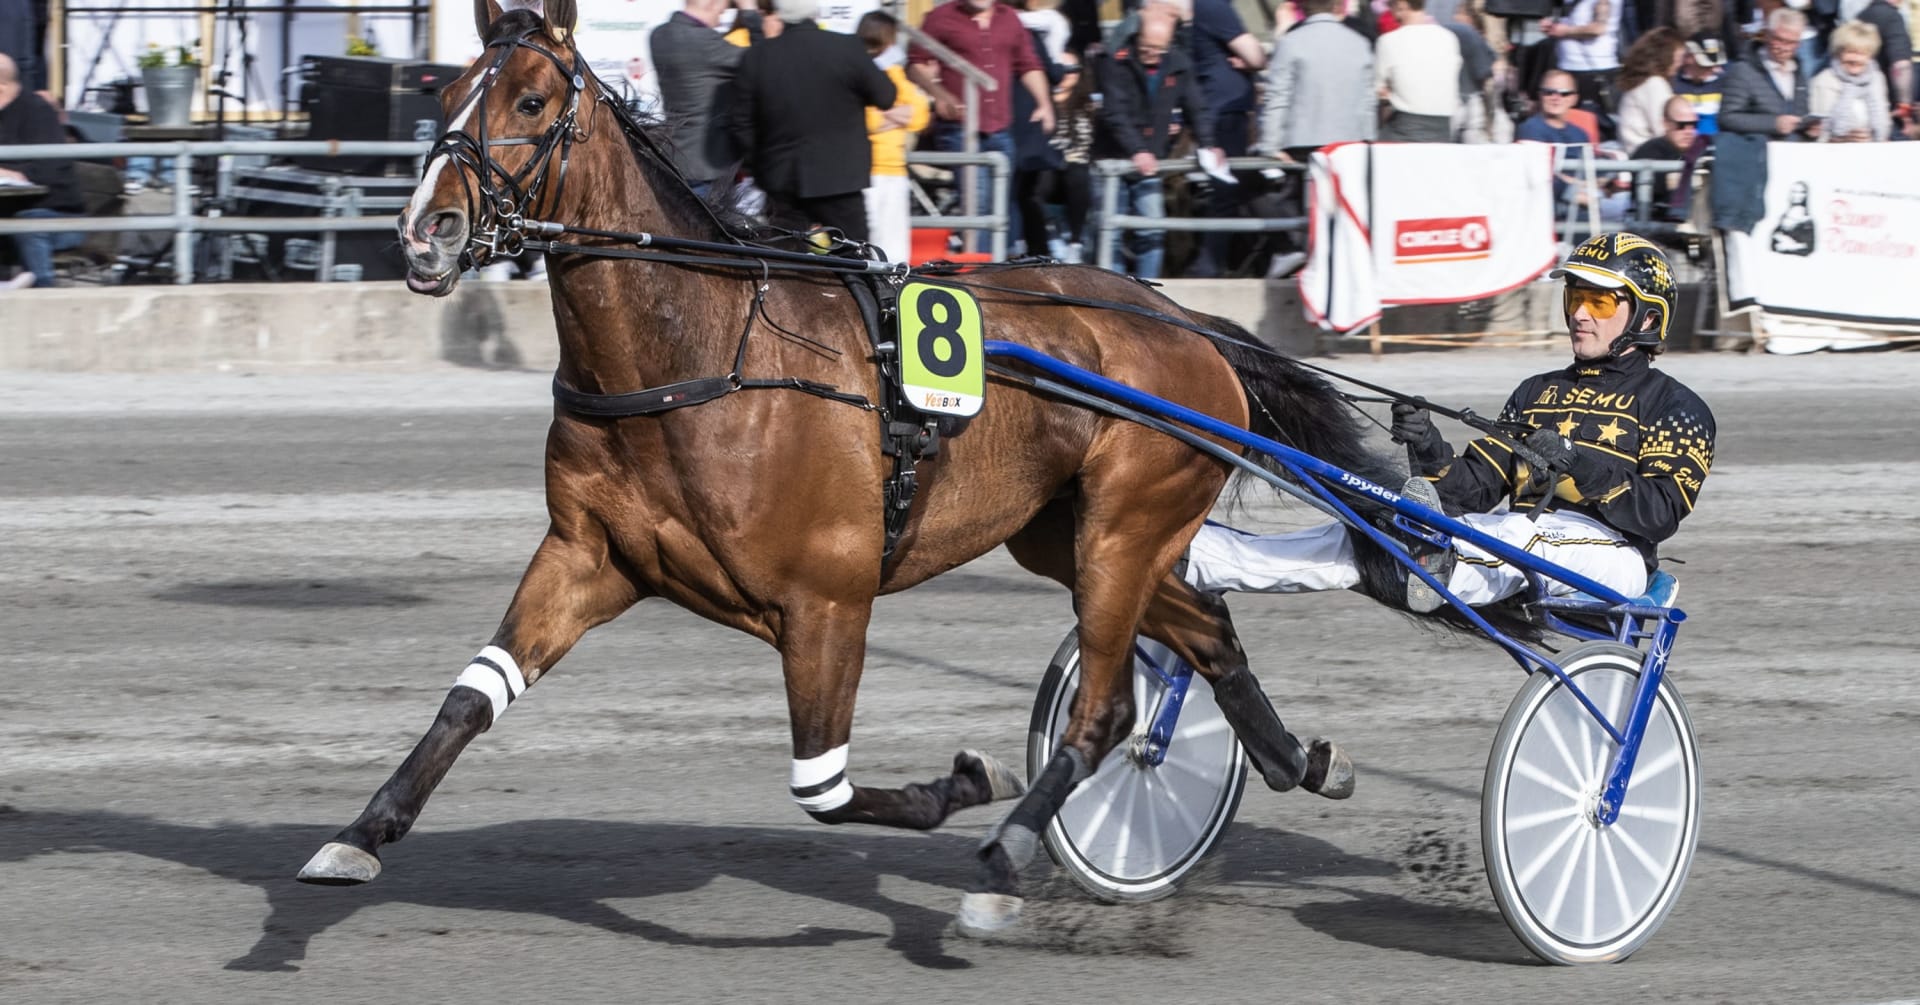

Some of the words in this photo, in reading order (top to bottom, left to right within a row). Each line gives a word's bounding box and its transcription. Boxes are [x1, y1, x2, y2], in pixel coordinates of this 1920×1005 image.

[1399, 228, 1461, 248] CIRCLE
[1572, 246, 1609, 261] SEMU
[916, 288, 967, 378] 8
[1561, 387, 1635, 410] SEMU
[1341, 473, 1401, 503] spyder
[1648, 460, 1673, 472] om
[1674, 467, 1701, 492] Erik
